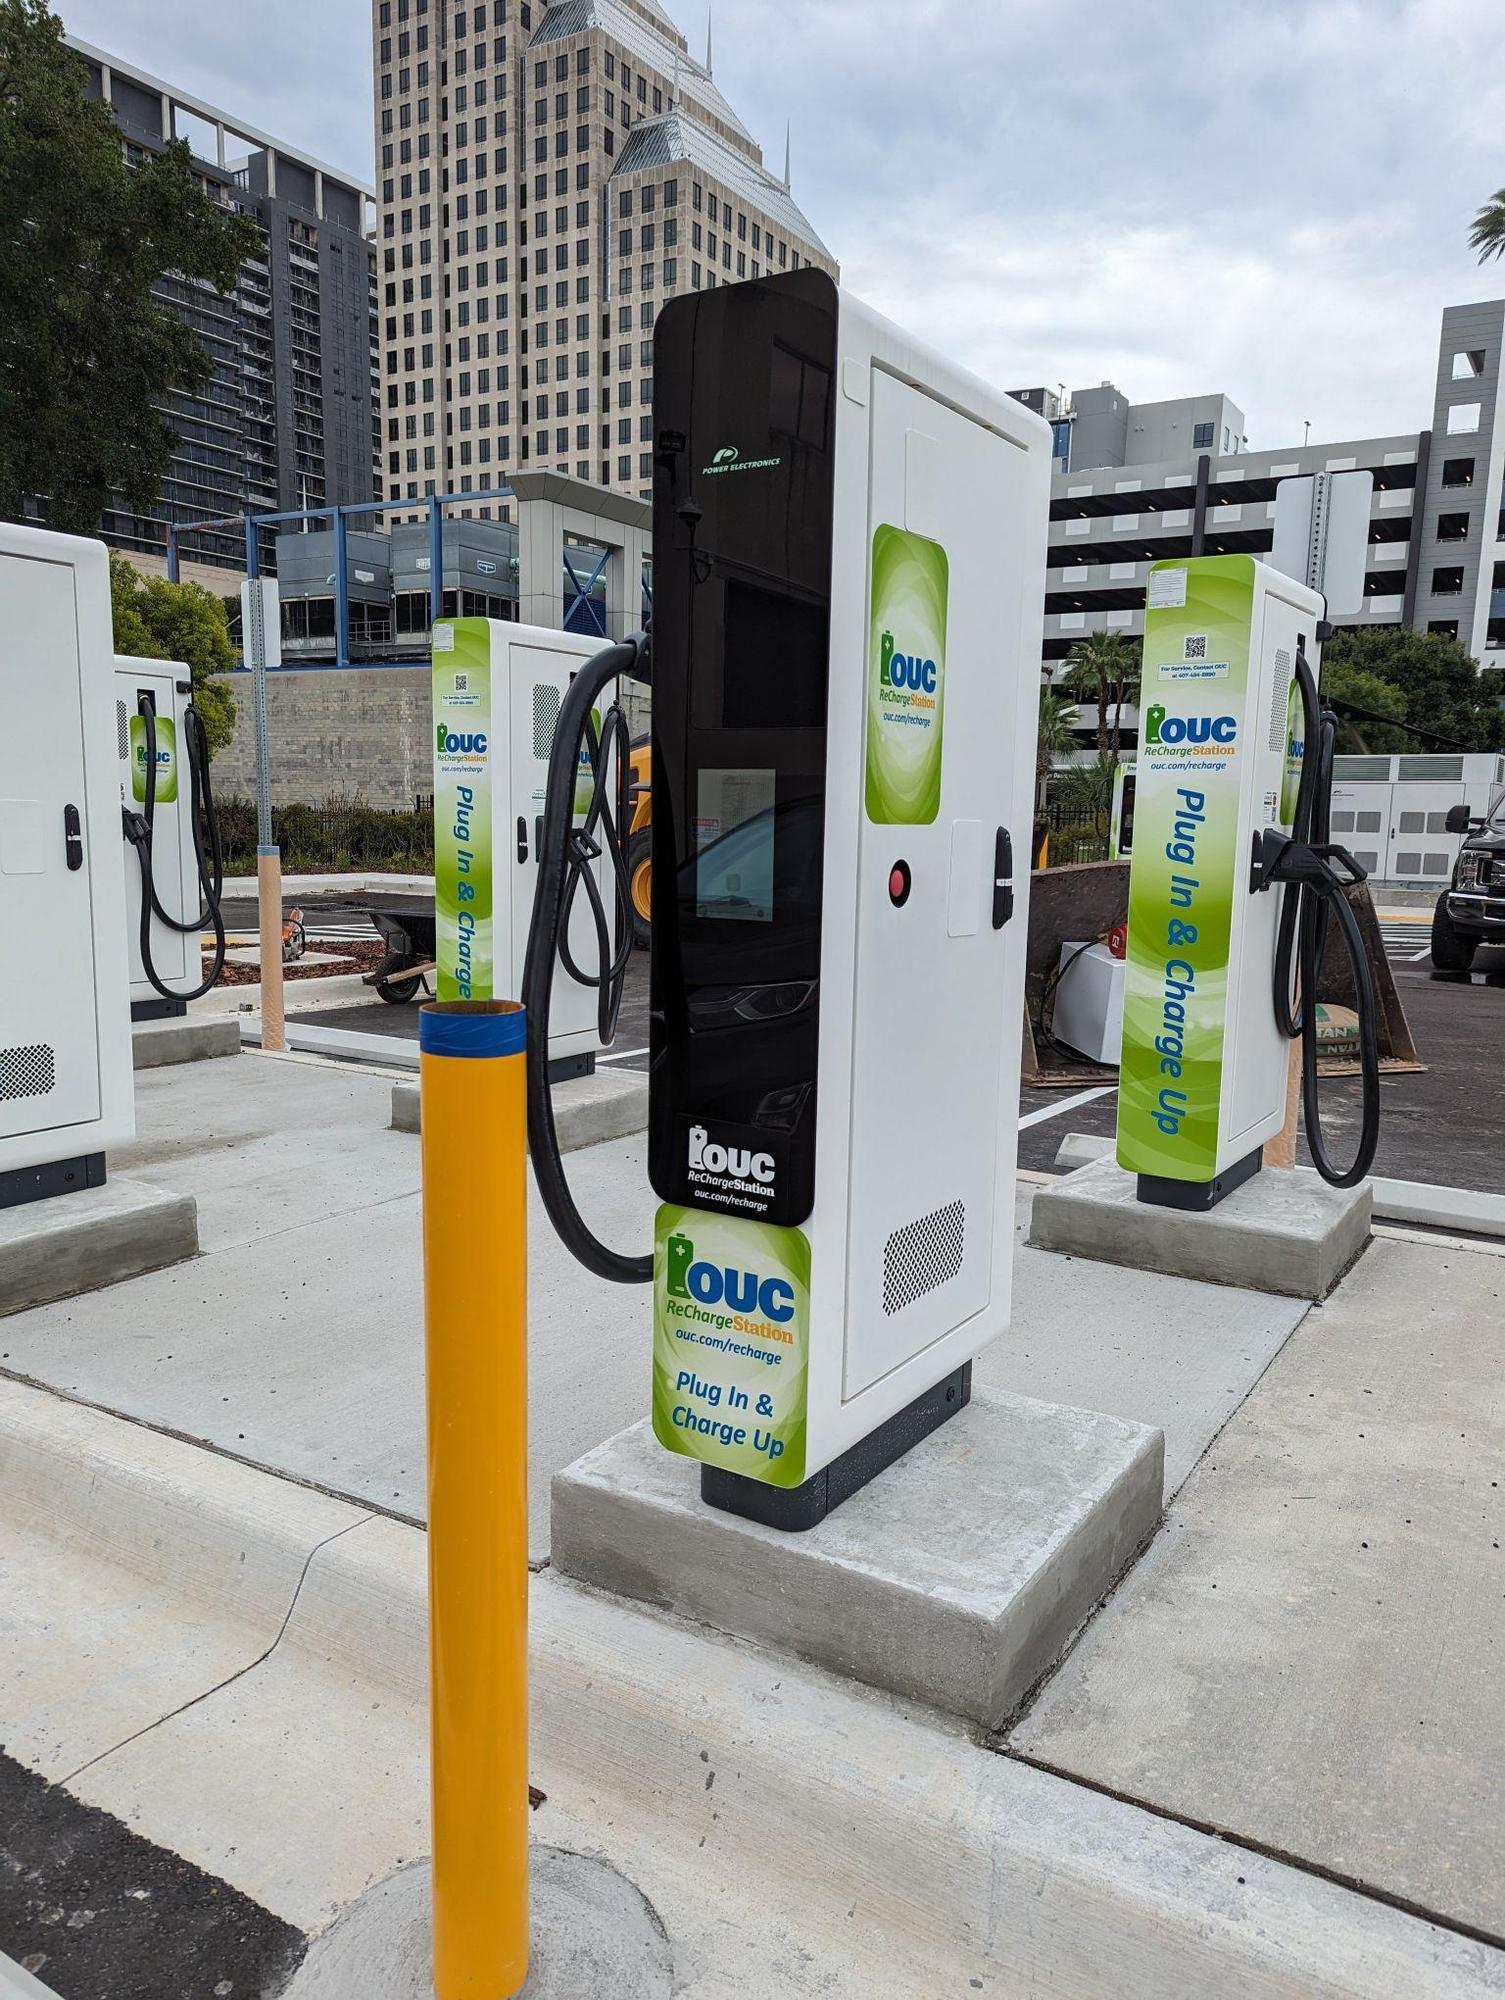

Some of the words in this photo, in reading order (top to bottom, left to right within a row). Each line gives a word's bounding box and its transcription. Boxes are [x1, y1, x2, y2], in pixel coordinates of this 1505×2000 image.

[702, 465, 729, 475] POWER
[730, 458, 781, 471] ELECTRONICS
[880, 688, 936, 709] ReChargeStation
[883, 712, 931, 728] ouc.com/recharge
[437, 754, 488, 763] ReChargeStation
[1144, 745, 1235, 758] ReChargeStation
[441, 765, 483, 773] ouc.com/recharge
[1150, 761, 1227, 772] ouc.com/recharge
[453, 785, 474, 841] Plug
[1165, 787, 1206, 865] Plug
[457, 849, 474, 874] In
[457, 881, 475, 902] &
[1169, 874, 1200, 909] In
[1167, 918, 1198, 947] &
[455, 911, 476, 999] Charge
[1154, 959, 1196, 1079] Charge
[1316, 1027, 1347, 1038] TAN
[1150, 1087, 1188, 1136] Up
[687, 1170, 776, 1198] ReChargeStation
[693, 1189, 769, 1212] ouc.com/recharge
[666, 1299, 794, 1345] ReChargeStation
[675, 1327, 783, 1365] ouc.com/recharge
[675, 1371, 722, 1407] Plug
[728, 1385, 748, 1410] In
[755, 1393, 774, 1418] &
[671, 1405, 747, 1446] Charge
[753, 1429, 785, 1460] Up
